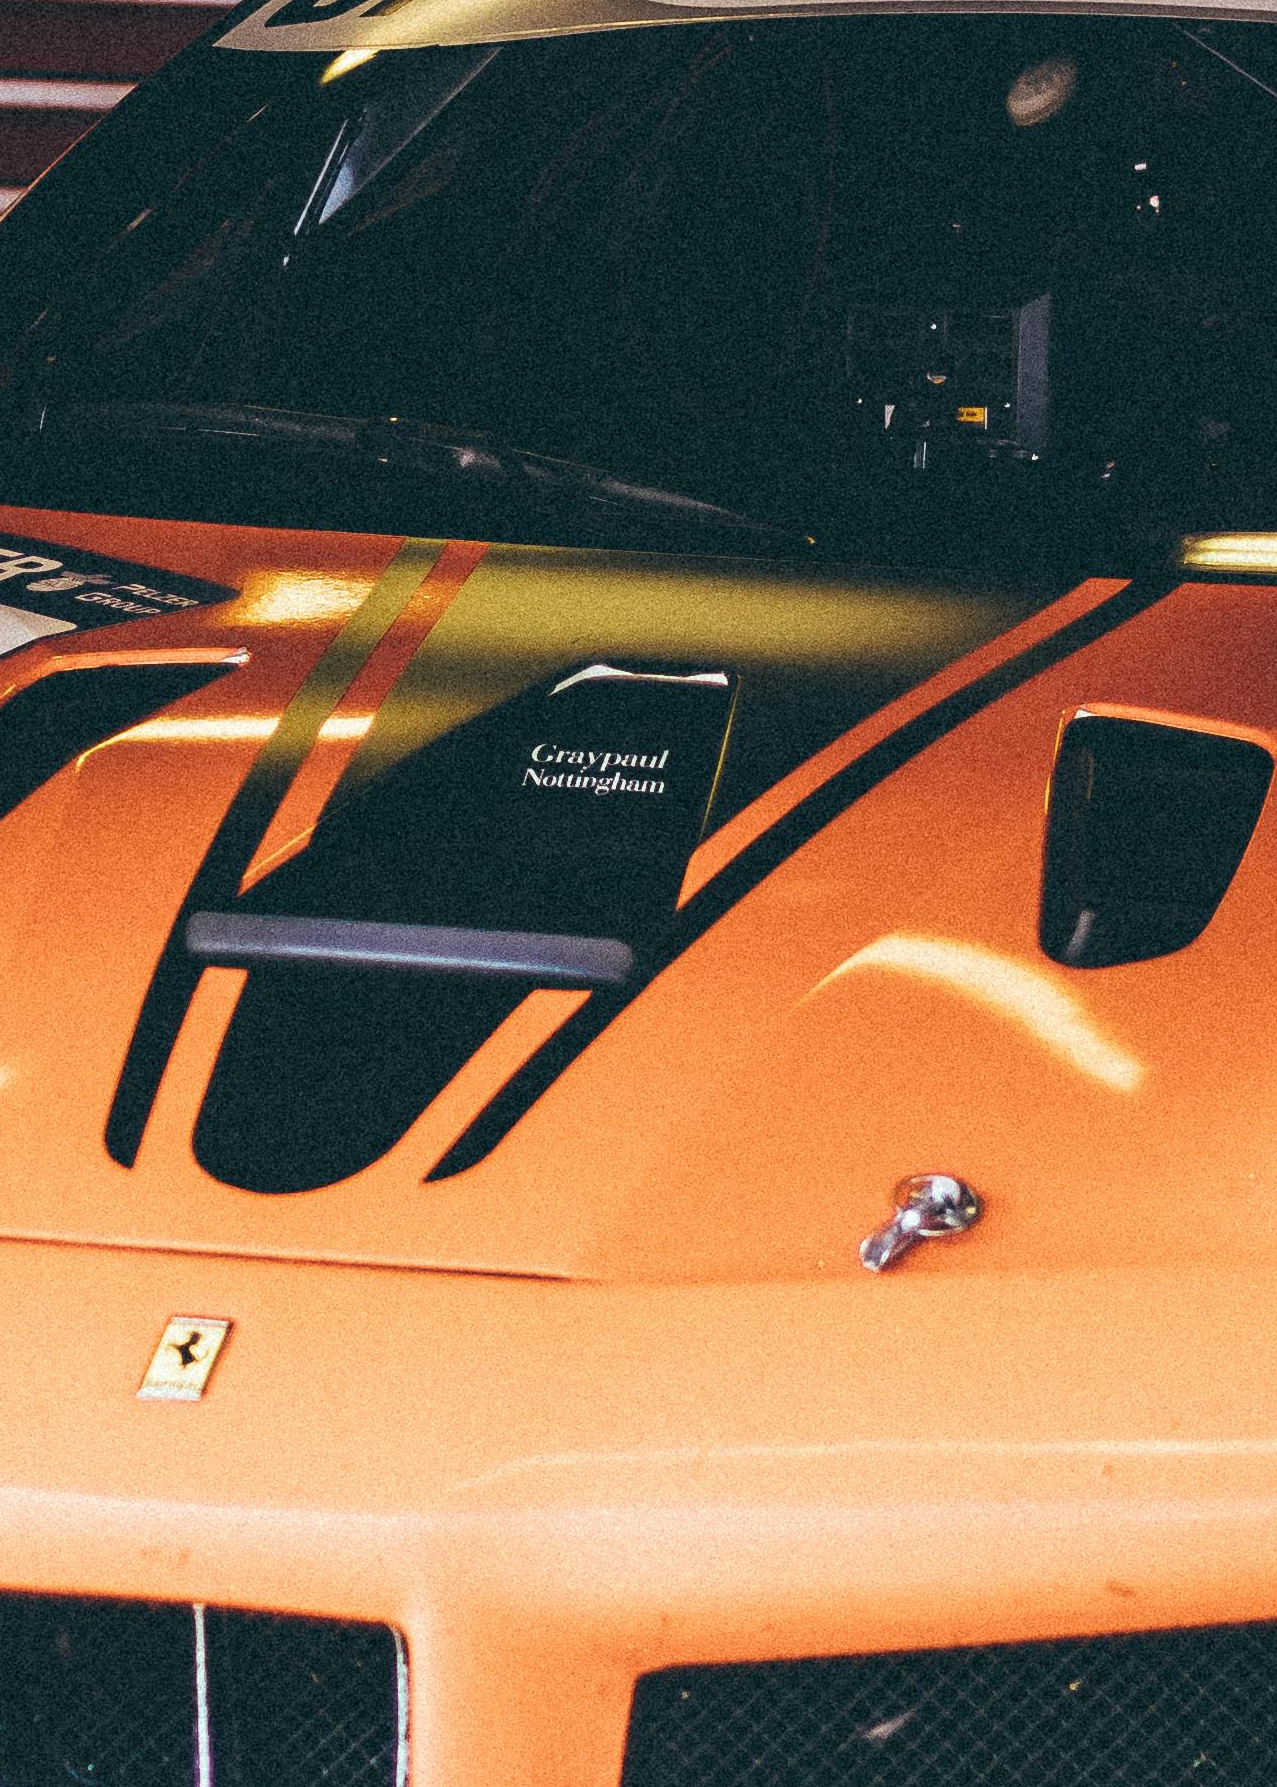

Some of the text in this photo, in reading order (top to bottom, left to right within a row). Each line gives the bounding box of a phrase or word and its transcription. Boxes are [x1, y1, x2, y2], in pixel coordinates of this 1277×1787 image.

[74, 592, 162, 614] GROUP
[531, 743, 670, 773] Graypaul
[522, 768, 666, 795] Nottingham
